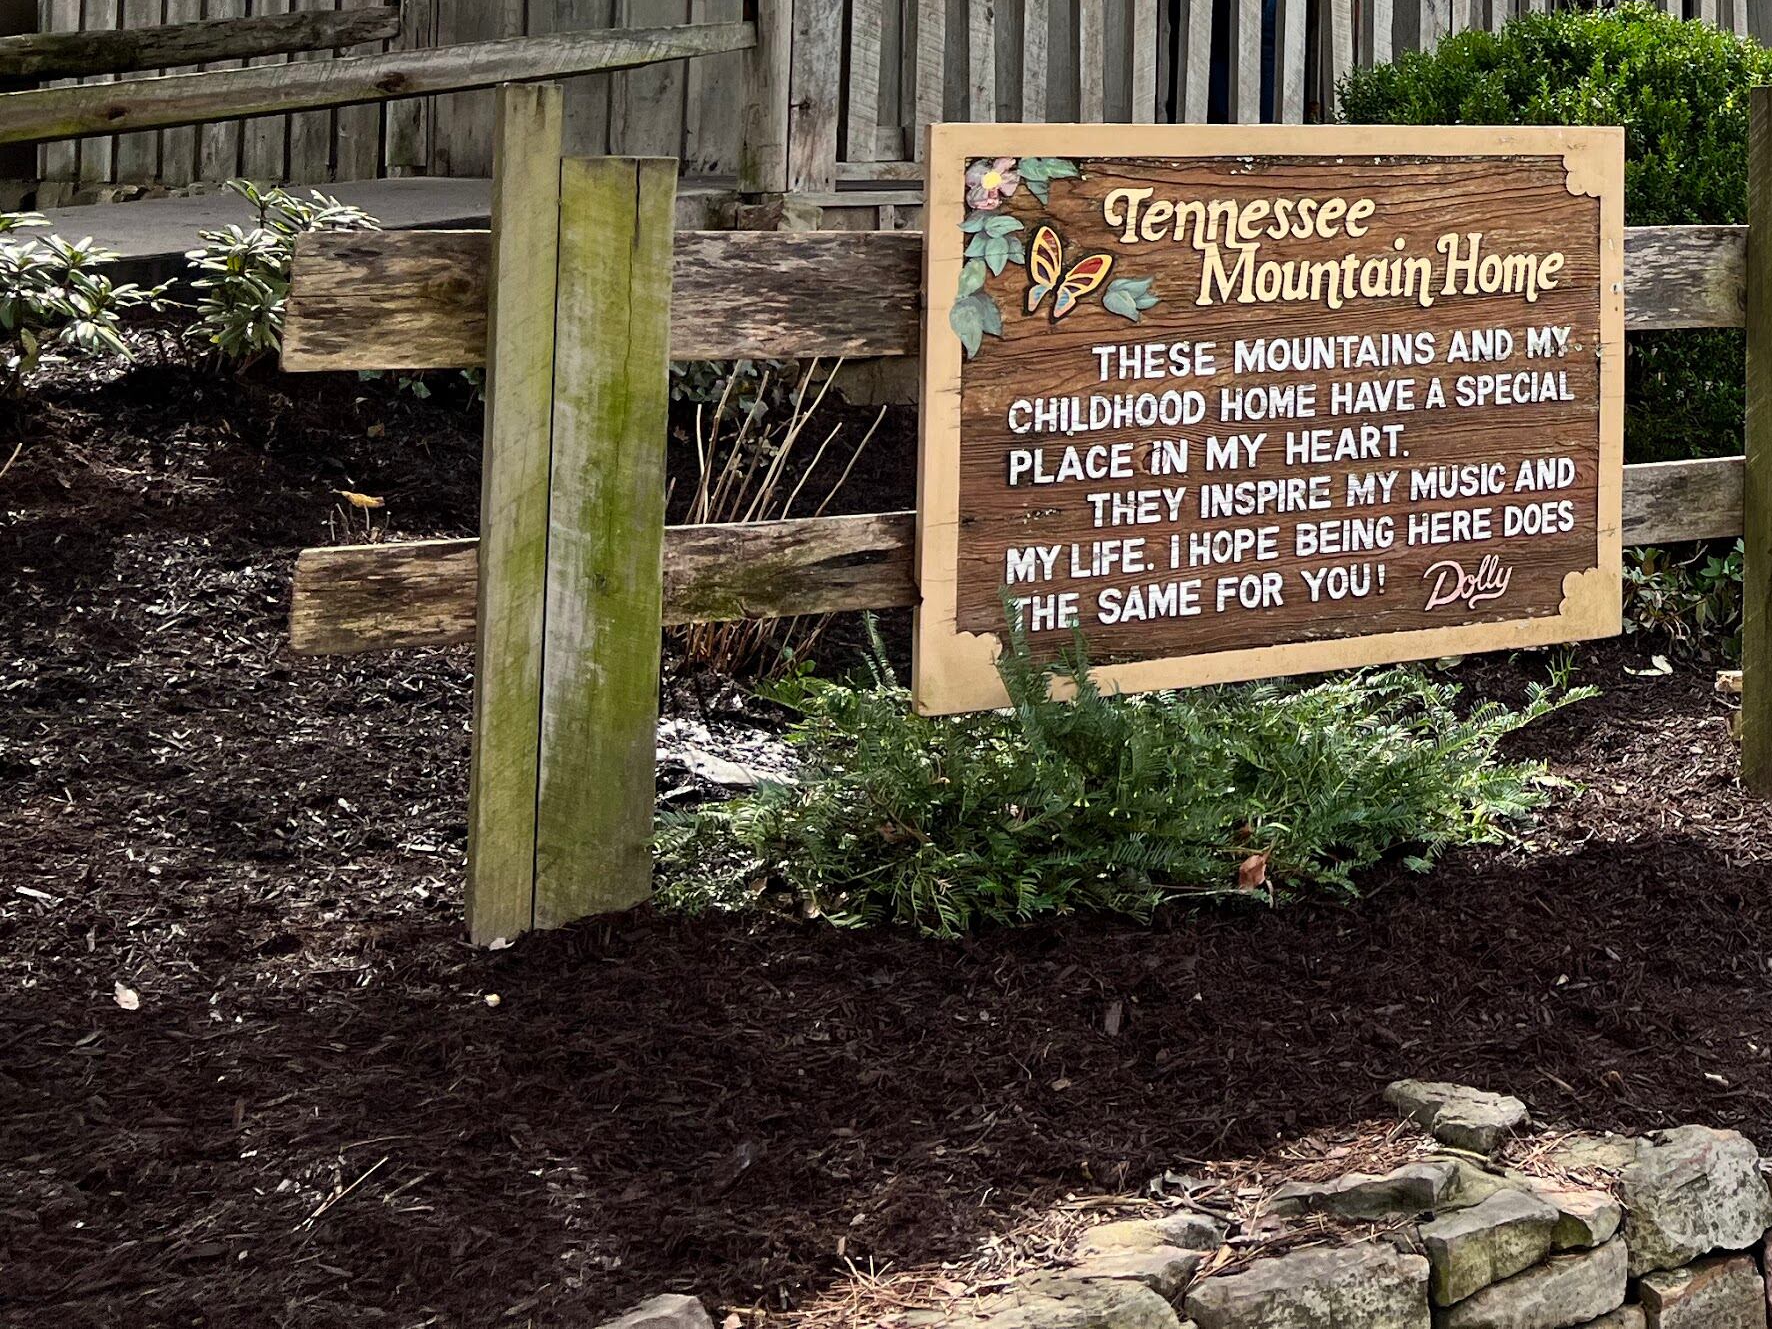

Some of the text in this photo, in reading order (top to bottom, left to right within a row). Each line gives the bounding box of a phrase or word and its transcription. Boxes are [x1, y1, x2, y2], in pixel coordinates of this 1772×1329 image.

[1103, 186, 1376, 249] Tennessee
[1195, 232, 1565, 310] Mountain Home
[1091, 326, 1572, 382] THESE MOUNTAINS AND MY
[1008, 369, 1576, 435] CHILDHOOD HOME HAVE A SPECIAL
[1009, 422, 1410, 486] PLACE IN MY HEART.
[1086, 457, 1576, 528] THEY INSPIRE MY MUSIC AND
[1006, 499, 1576, 585] MY LIFE. I HOPE BEING HERE DOES
[1008, 562, 1386, 632] THE SAME FOR YOU!
[1422, 553, 1514, 612] Dolly
